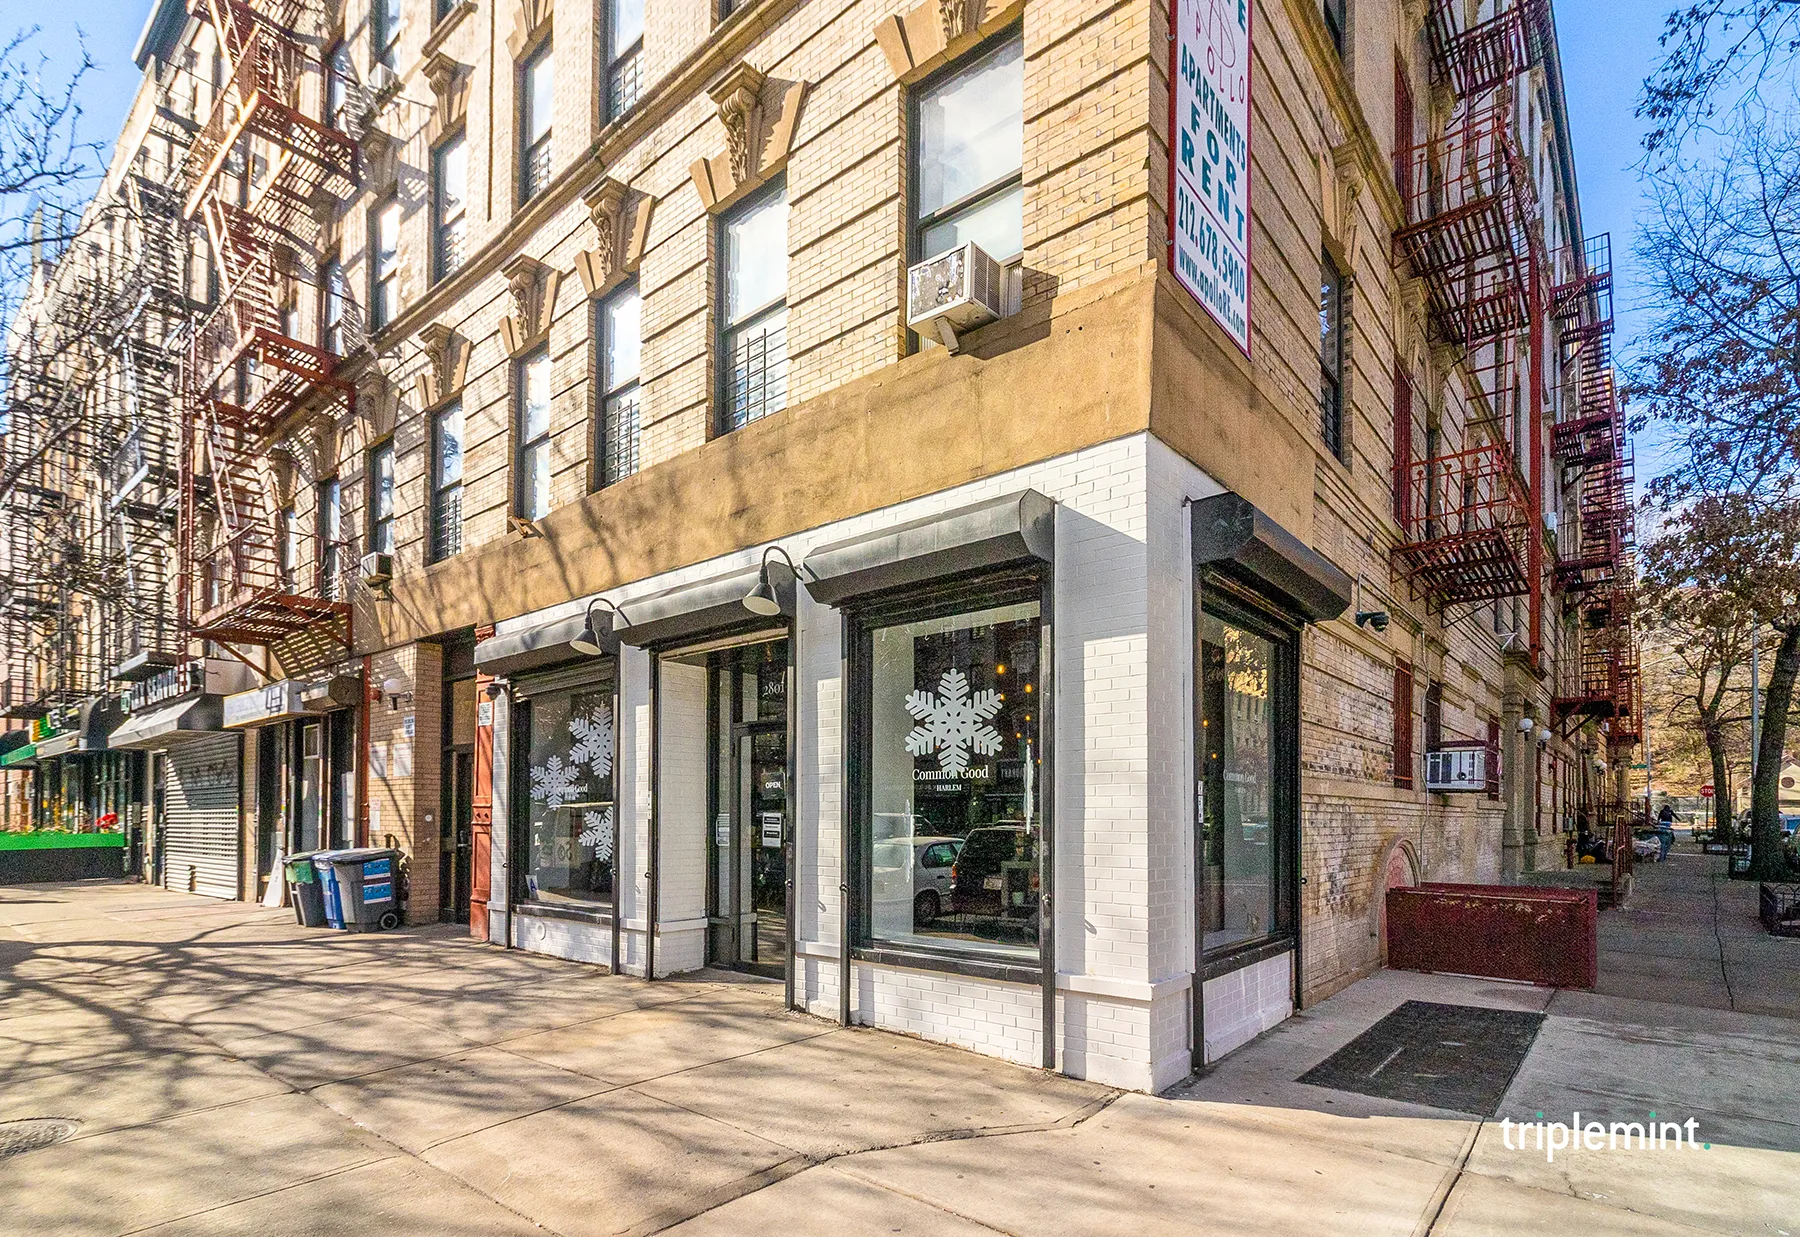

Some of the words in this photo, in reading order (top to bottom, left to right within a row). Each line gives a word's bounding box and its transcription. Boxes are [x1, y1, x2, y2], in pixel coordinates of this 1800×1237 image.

[1181, 42, 1246, 172] APARTMENTS
[1190, 99, 1237, 196] FOR
[1181, 126, 1245, 243] RENT
[1178, 186, 1245, 304] 212.678.5900
[912, 768, 959, 781] Common
[960, 765, 989, 779] Good
[936, 784, 962, 792] HARLEM
